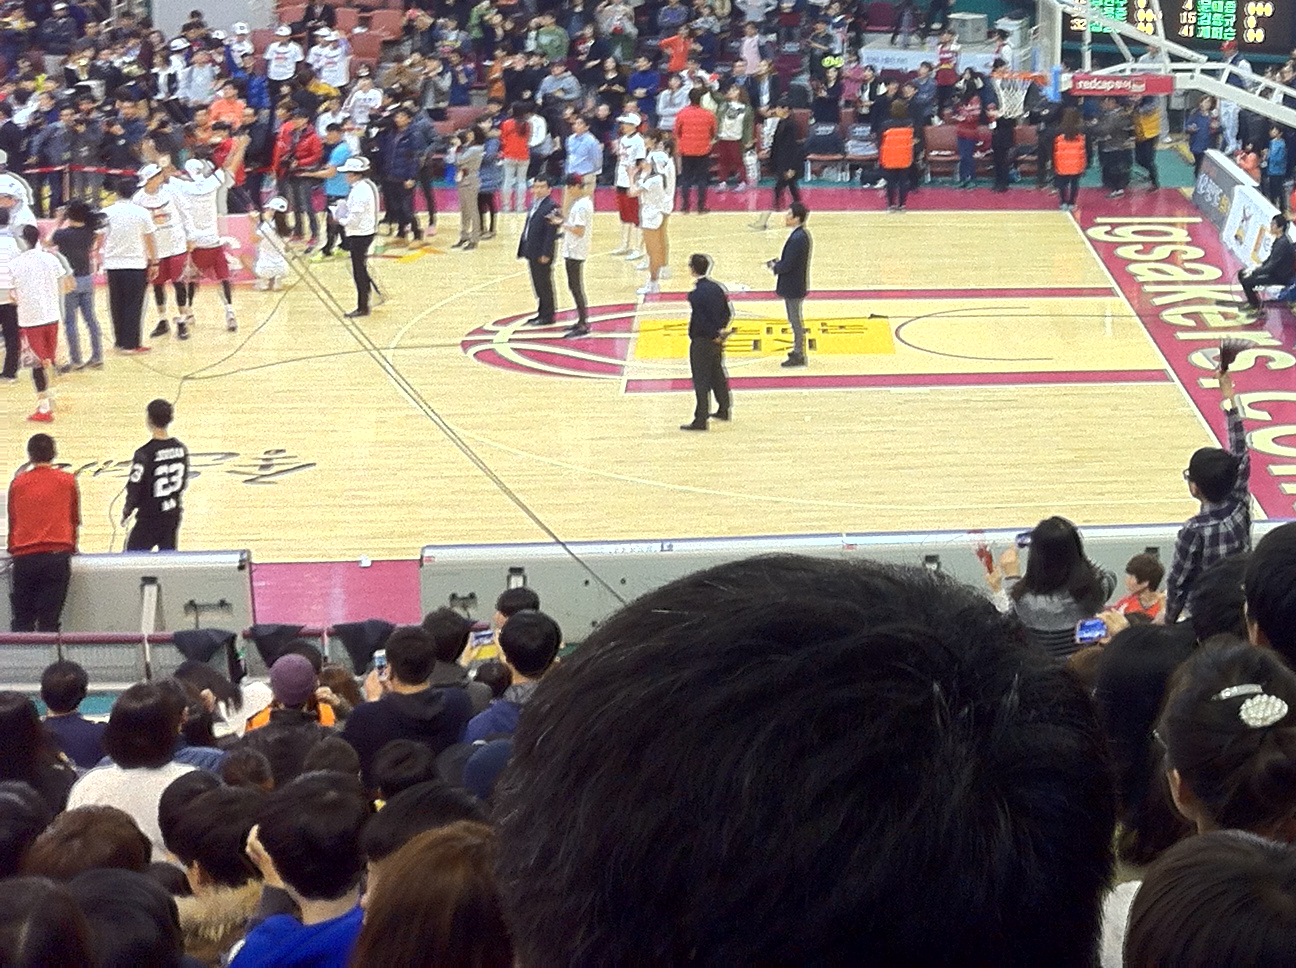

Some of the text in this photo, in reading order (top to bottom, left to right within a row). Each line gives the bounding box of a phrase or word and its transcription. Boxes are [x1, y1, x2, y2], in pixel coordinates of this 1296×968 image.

[1182, 0, 1194, 11] 4
[1179, 11, 1197, 25] 15
[1178, 24, 1195, 38] 41
[152, 461, 186, 499] 23
